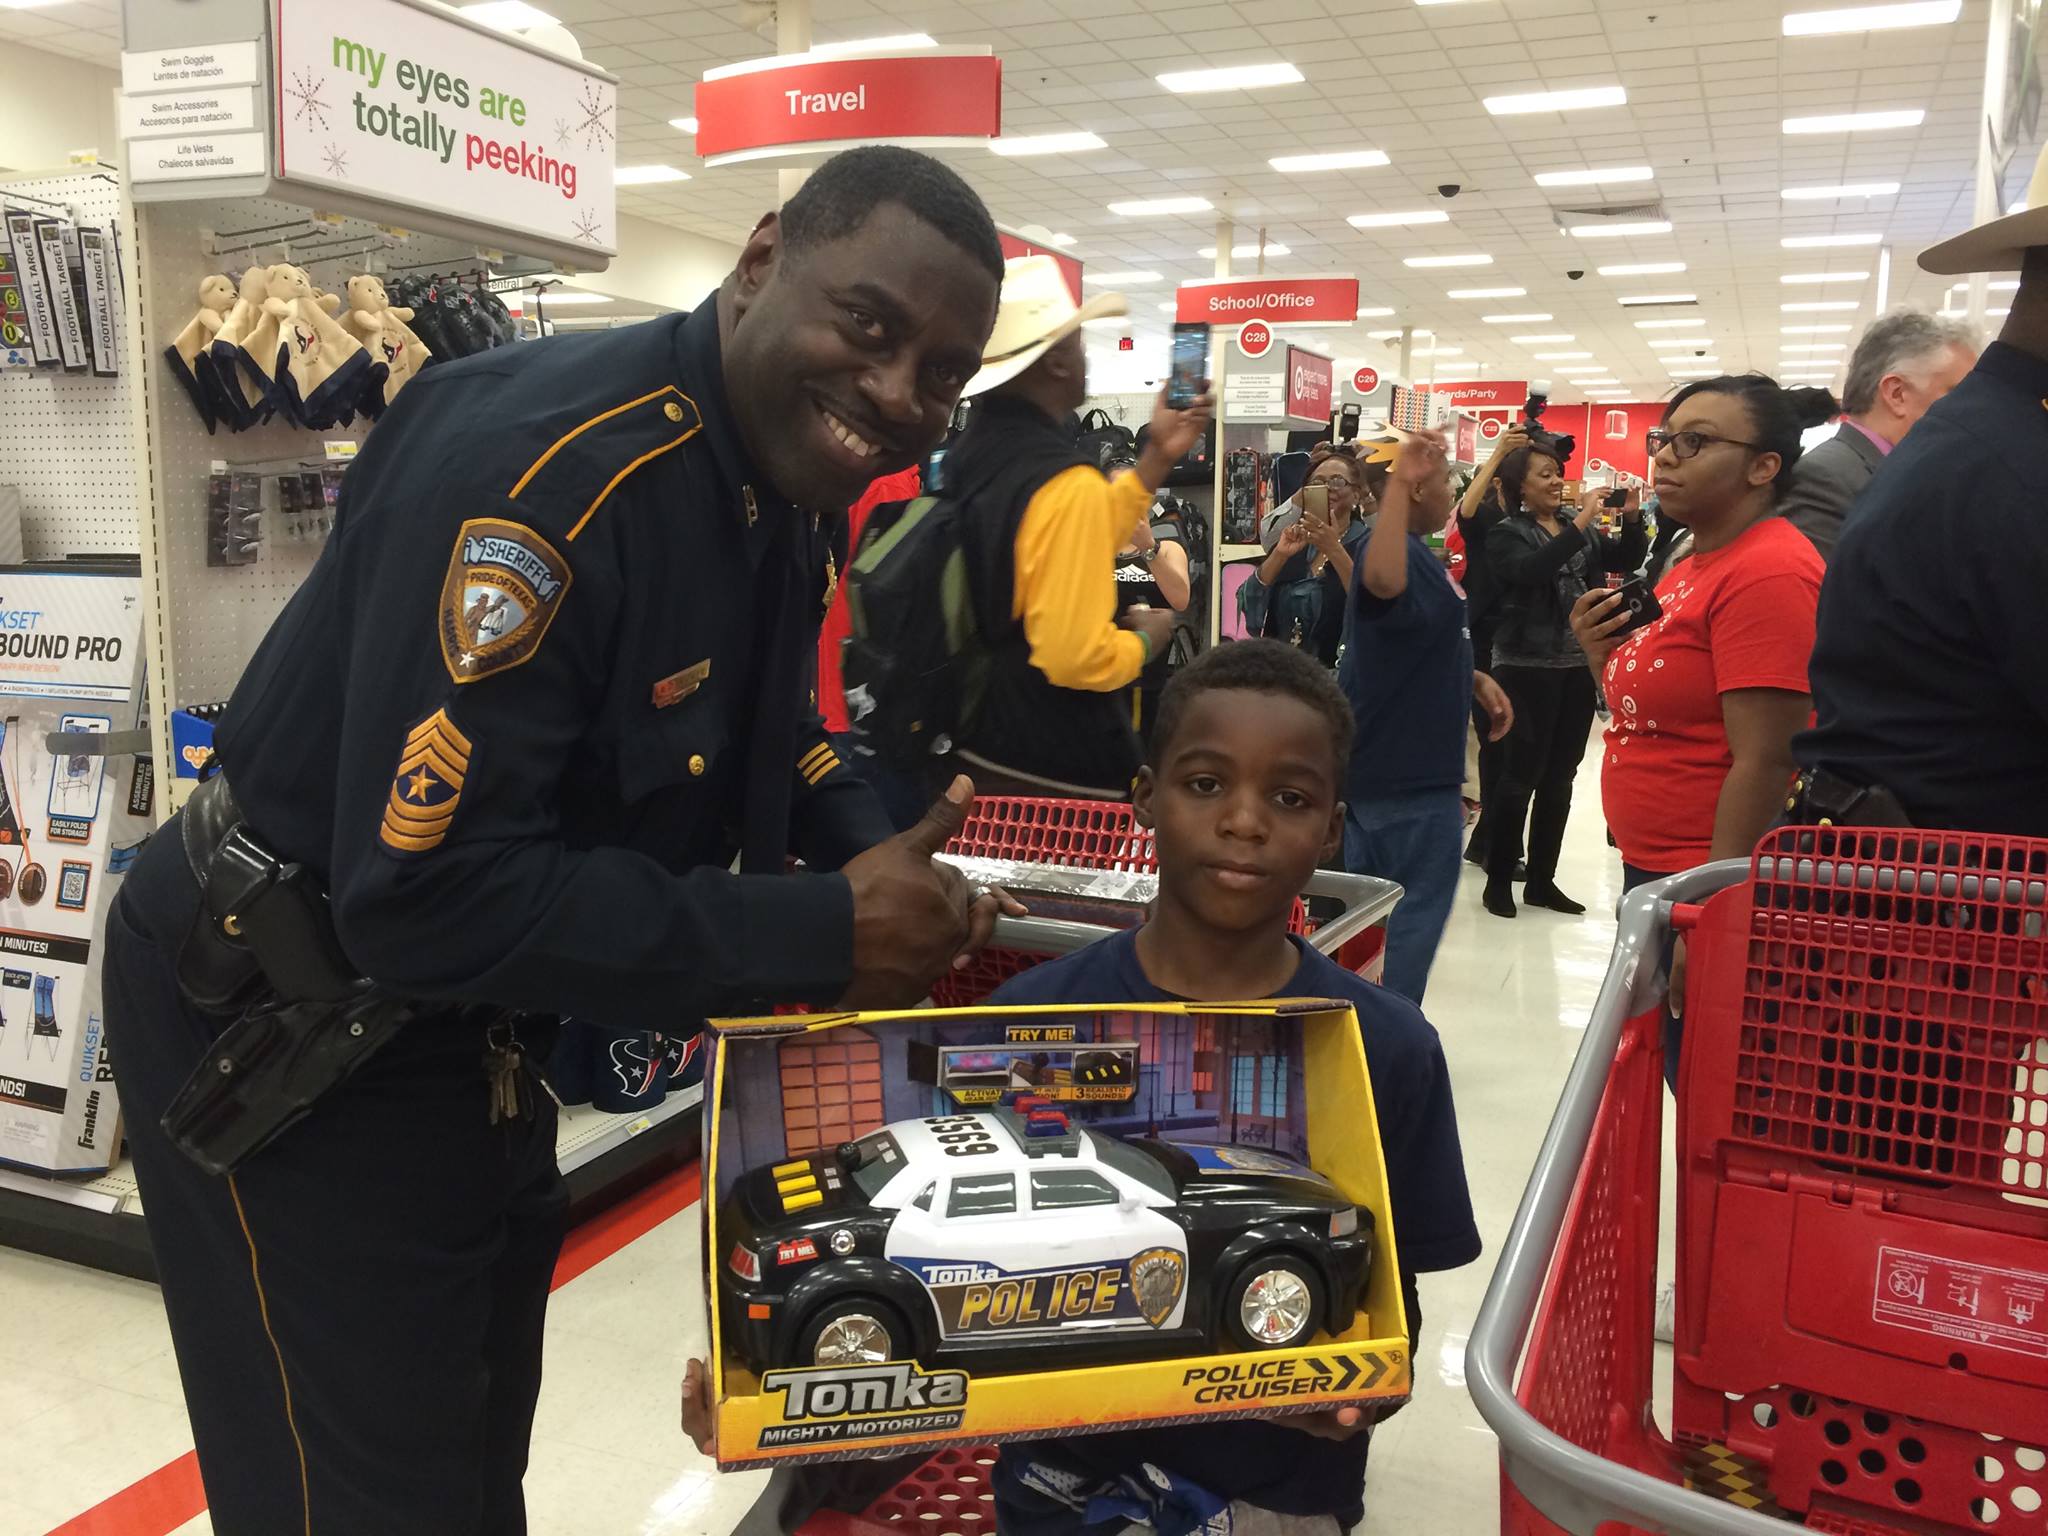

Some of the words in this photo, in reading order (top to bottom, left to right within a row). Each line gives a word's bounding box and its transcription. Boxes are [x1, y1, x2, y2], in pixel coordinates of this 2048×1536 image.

[161, 58, 182, 67] Swim
[184, 54, 214, 66] Goggles
[154, 72, 178, 80] Lentes
[180, 70, 190, 78] de
[333, 36, 386, 88] my
[396, 59, 470, 109] eyes
[479, 87, 526, 126] are
[152, 104, 172, 112] Swim
[174, 100, 218, 111] Accessories
[785, 85, 865, 116] Travel
[182, 116, 198, 126] para
[178, 145, 191, 154] Life
[193, 144, 213, 153] Vests
[353, 92, 456, 164] totally
[466, 133, 576, 200] peeking
[158, 160, 194, 168] Chalecos
[195, 156, 234, 166] salvavidas
[24, 236, 38, 278] TARGET
[53, 243, 68, 284] TARGET
[94, 252, 104, 292] TARGET
[488, 278, 520, 290] entral
[32, 281, 50, 336] FOOTBALL
[1209, 293, 1315, 312] School/Office
[62, 288, 79, 342] FOOTBALL
[98, 296, 112, 348] FOOTBALL
[1245, 332, 1266, 342] C28
[1358, 376, 1374, 384] C26
[75, 636, 122, 662] PRO
[132, 763, 145, 809] ASSEMBLES
[52, 820, 70, 829] EASILY
[71, 822, 88, 830] FOLDS
[4, 938, 48, 954] MINUTES!
[1010, 1029, 1040, 1040] TRY
[1045, 1028, 1072, 1040] ME!
[80, 1016, 100, 1082] QUIKSET
[1076, 1088, 1084, 1098] 3
[780, 1249, 794, 1260] TRY
[922, 1264, 999, 1284] Tonka
[958, 1268, 1122, 1328] POLICE
[1933, 1323, 1976, 1340] WARNING
[1182, 1359, 1298, 1386] POLICE
[766, 1364, 966, 1416] Tonka
[1194, 1376, 1333, 1403] CRUISER
[764, 1424, 841, 1444] MIGHTY
[847, 1414, 959, 1434] MOTORIZED
